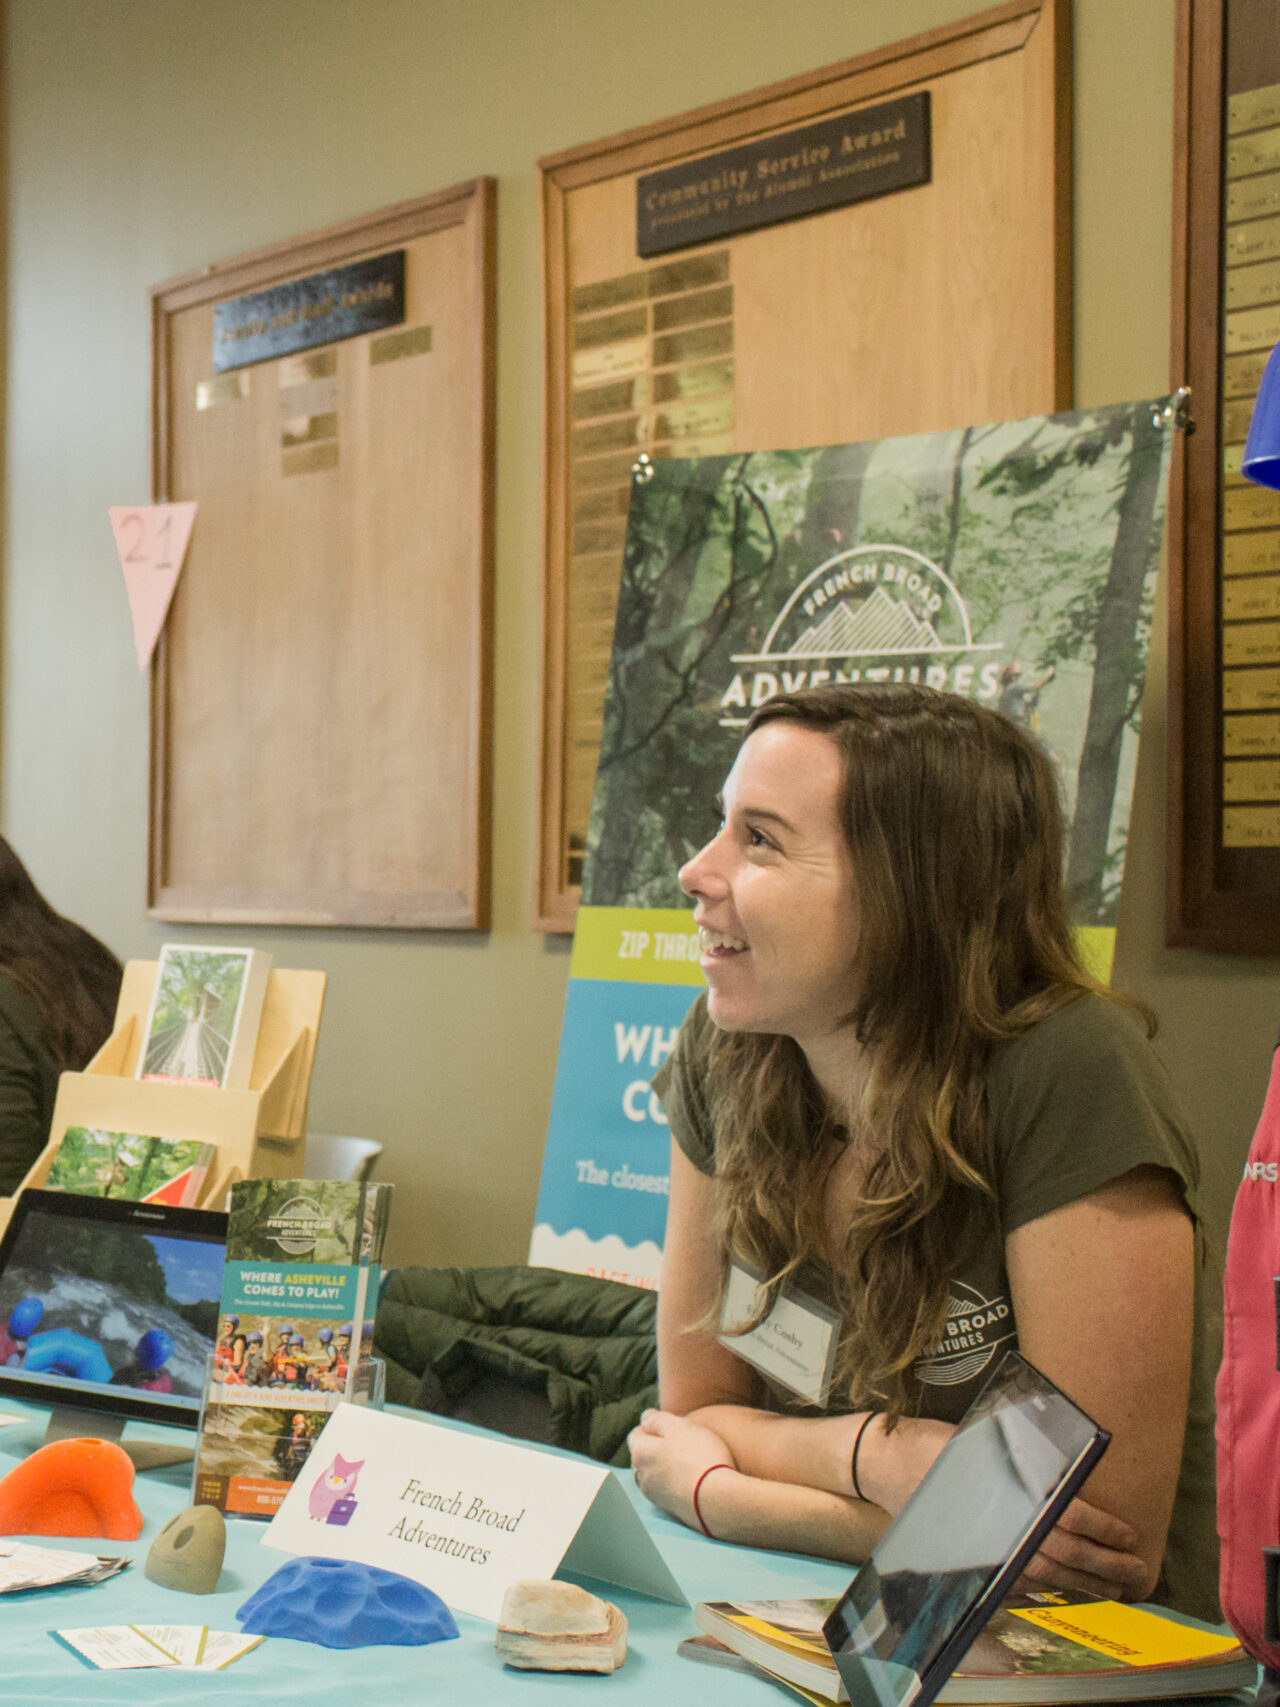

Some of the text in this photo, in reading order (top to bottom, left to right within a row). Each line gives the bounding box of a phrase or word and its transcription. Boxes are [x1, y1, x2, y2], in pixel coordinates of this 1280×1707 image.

[645, 119, 907, 211] Community Service Award
[802, 562, 943, 617] FRENCH BROAD
[617, 930, 650, 959] ZIP
[576, 1160, 670, 1196] The closest
[1242, 1161, 1278, 1182] NRS
[240, 1270, 346, 1287] WHERE ASHEVILLE
[243, 1283, 340, 1299] COMES TO PLAY!
[946, 1303, 1009, 1337] BROAD
[399, 1478, 526, 1533] French Broad
[387, 1515, 491, 1566] Adventures
[1026, 1608, 1143, 1656] Canyoneering
